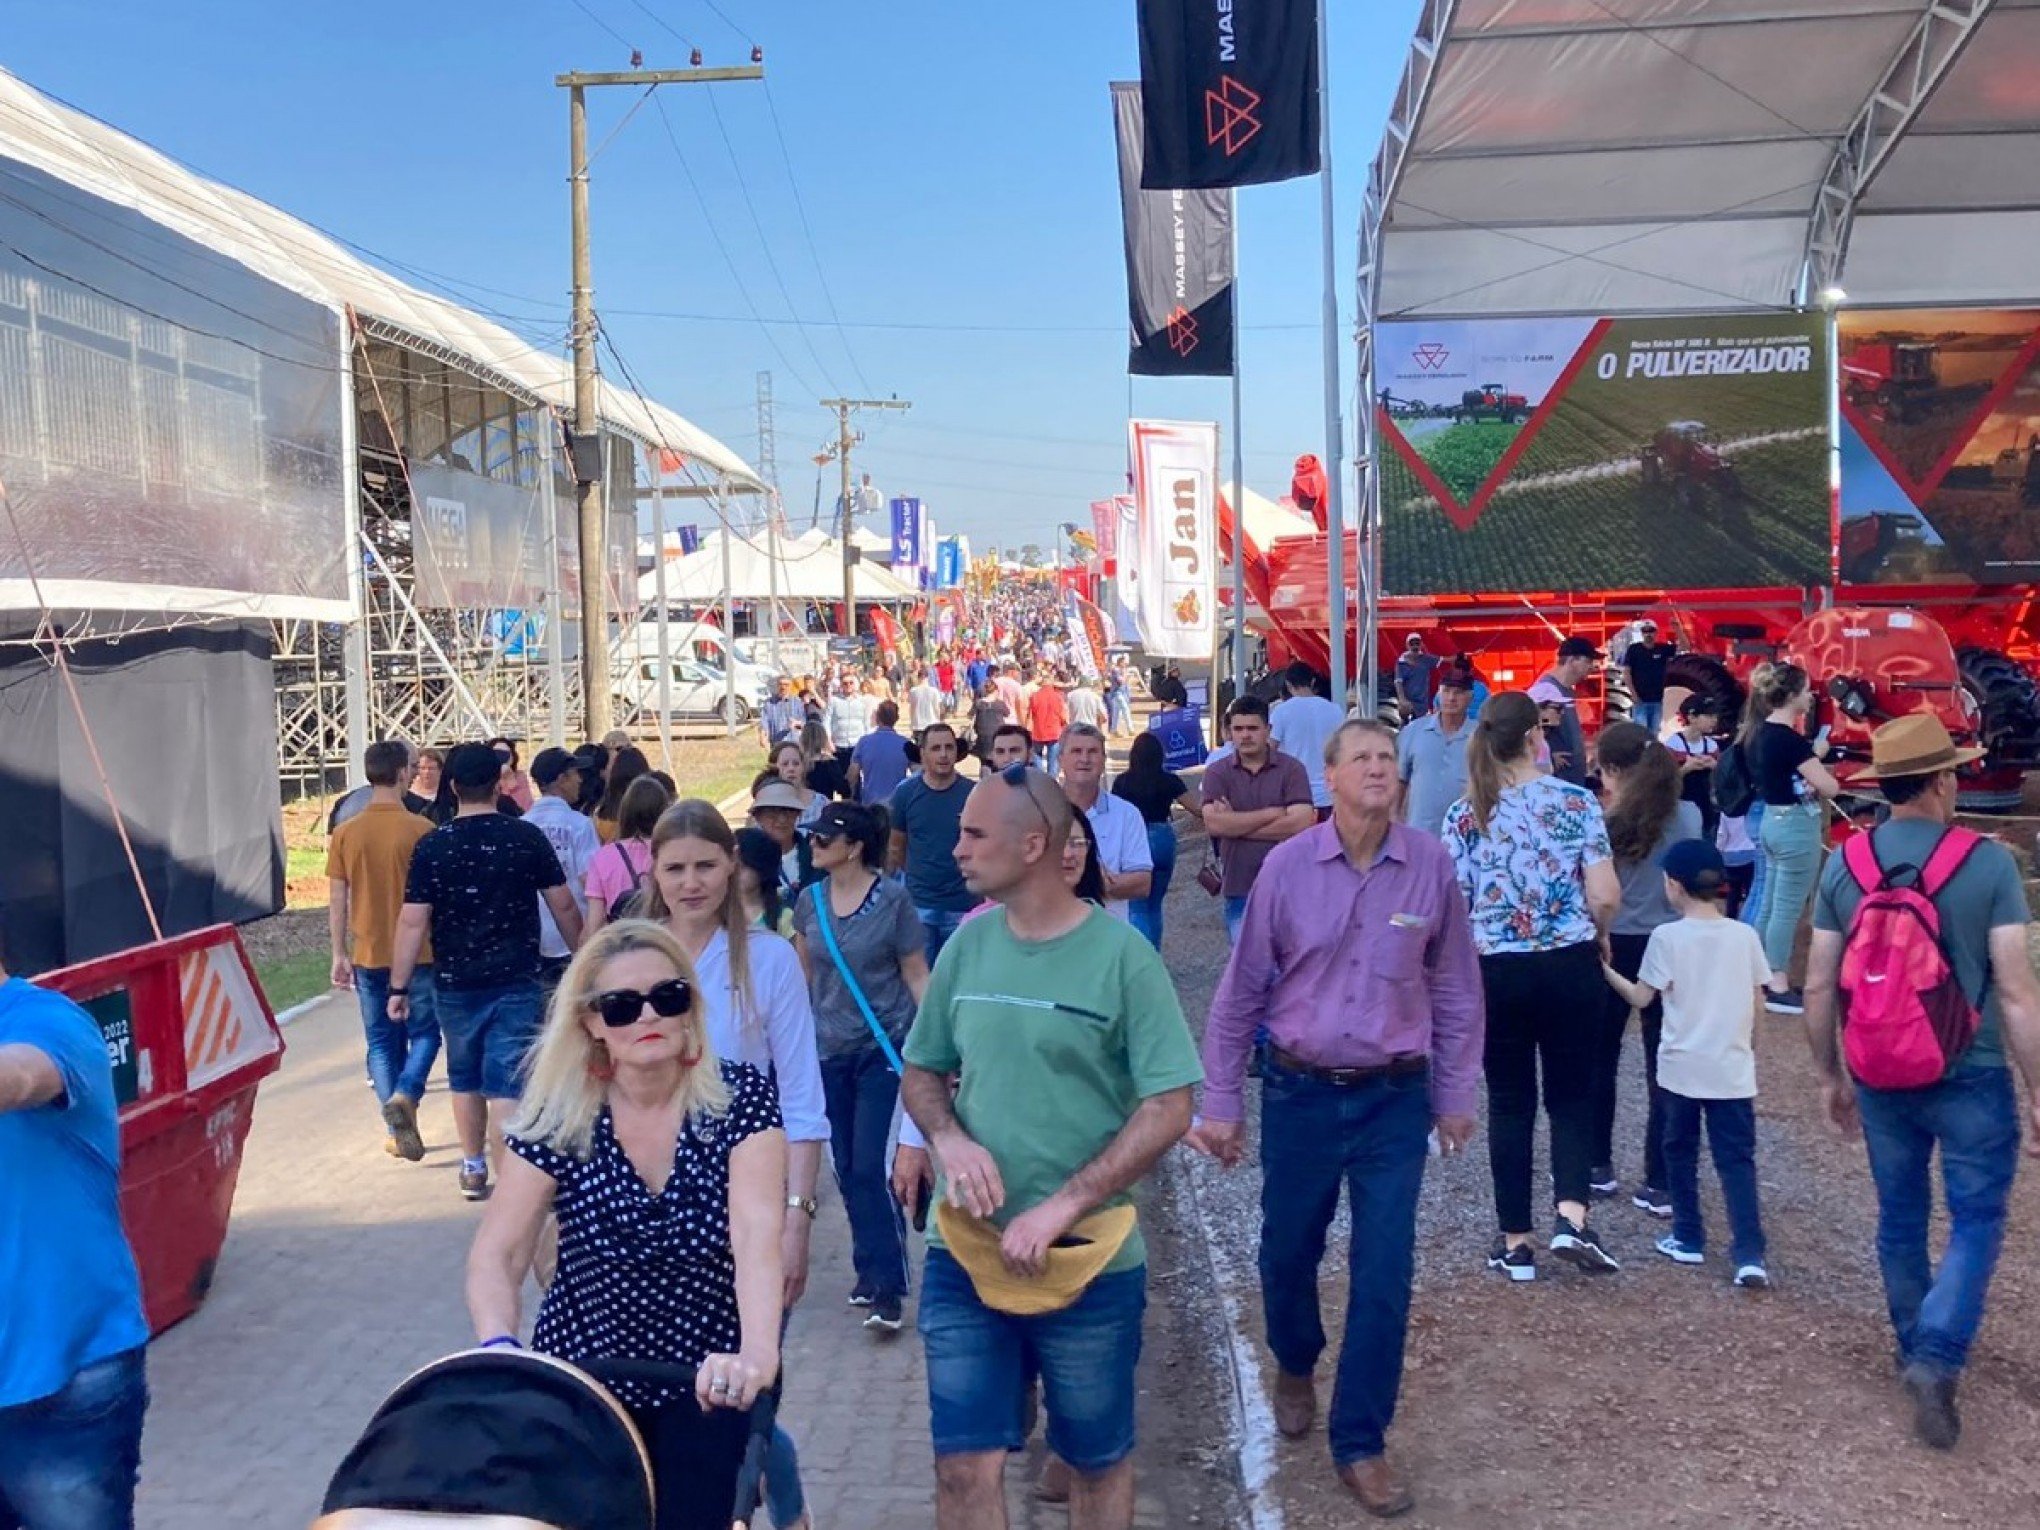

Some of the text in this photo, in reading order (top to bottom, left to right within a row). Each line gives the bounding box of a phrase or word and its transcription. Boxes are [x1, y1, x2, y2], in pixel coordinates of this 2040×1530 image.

[1174, 215, 1186, 298] MASSEY
[1597, 346, 1811, 380] O PULVERIZADOR
[898, 500, 912, 562] LS Tractor
[1169, 478, 1199, 574] Jan
[103, 1019, 129, 1040] 2022
